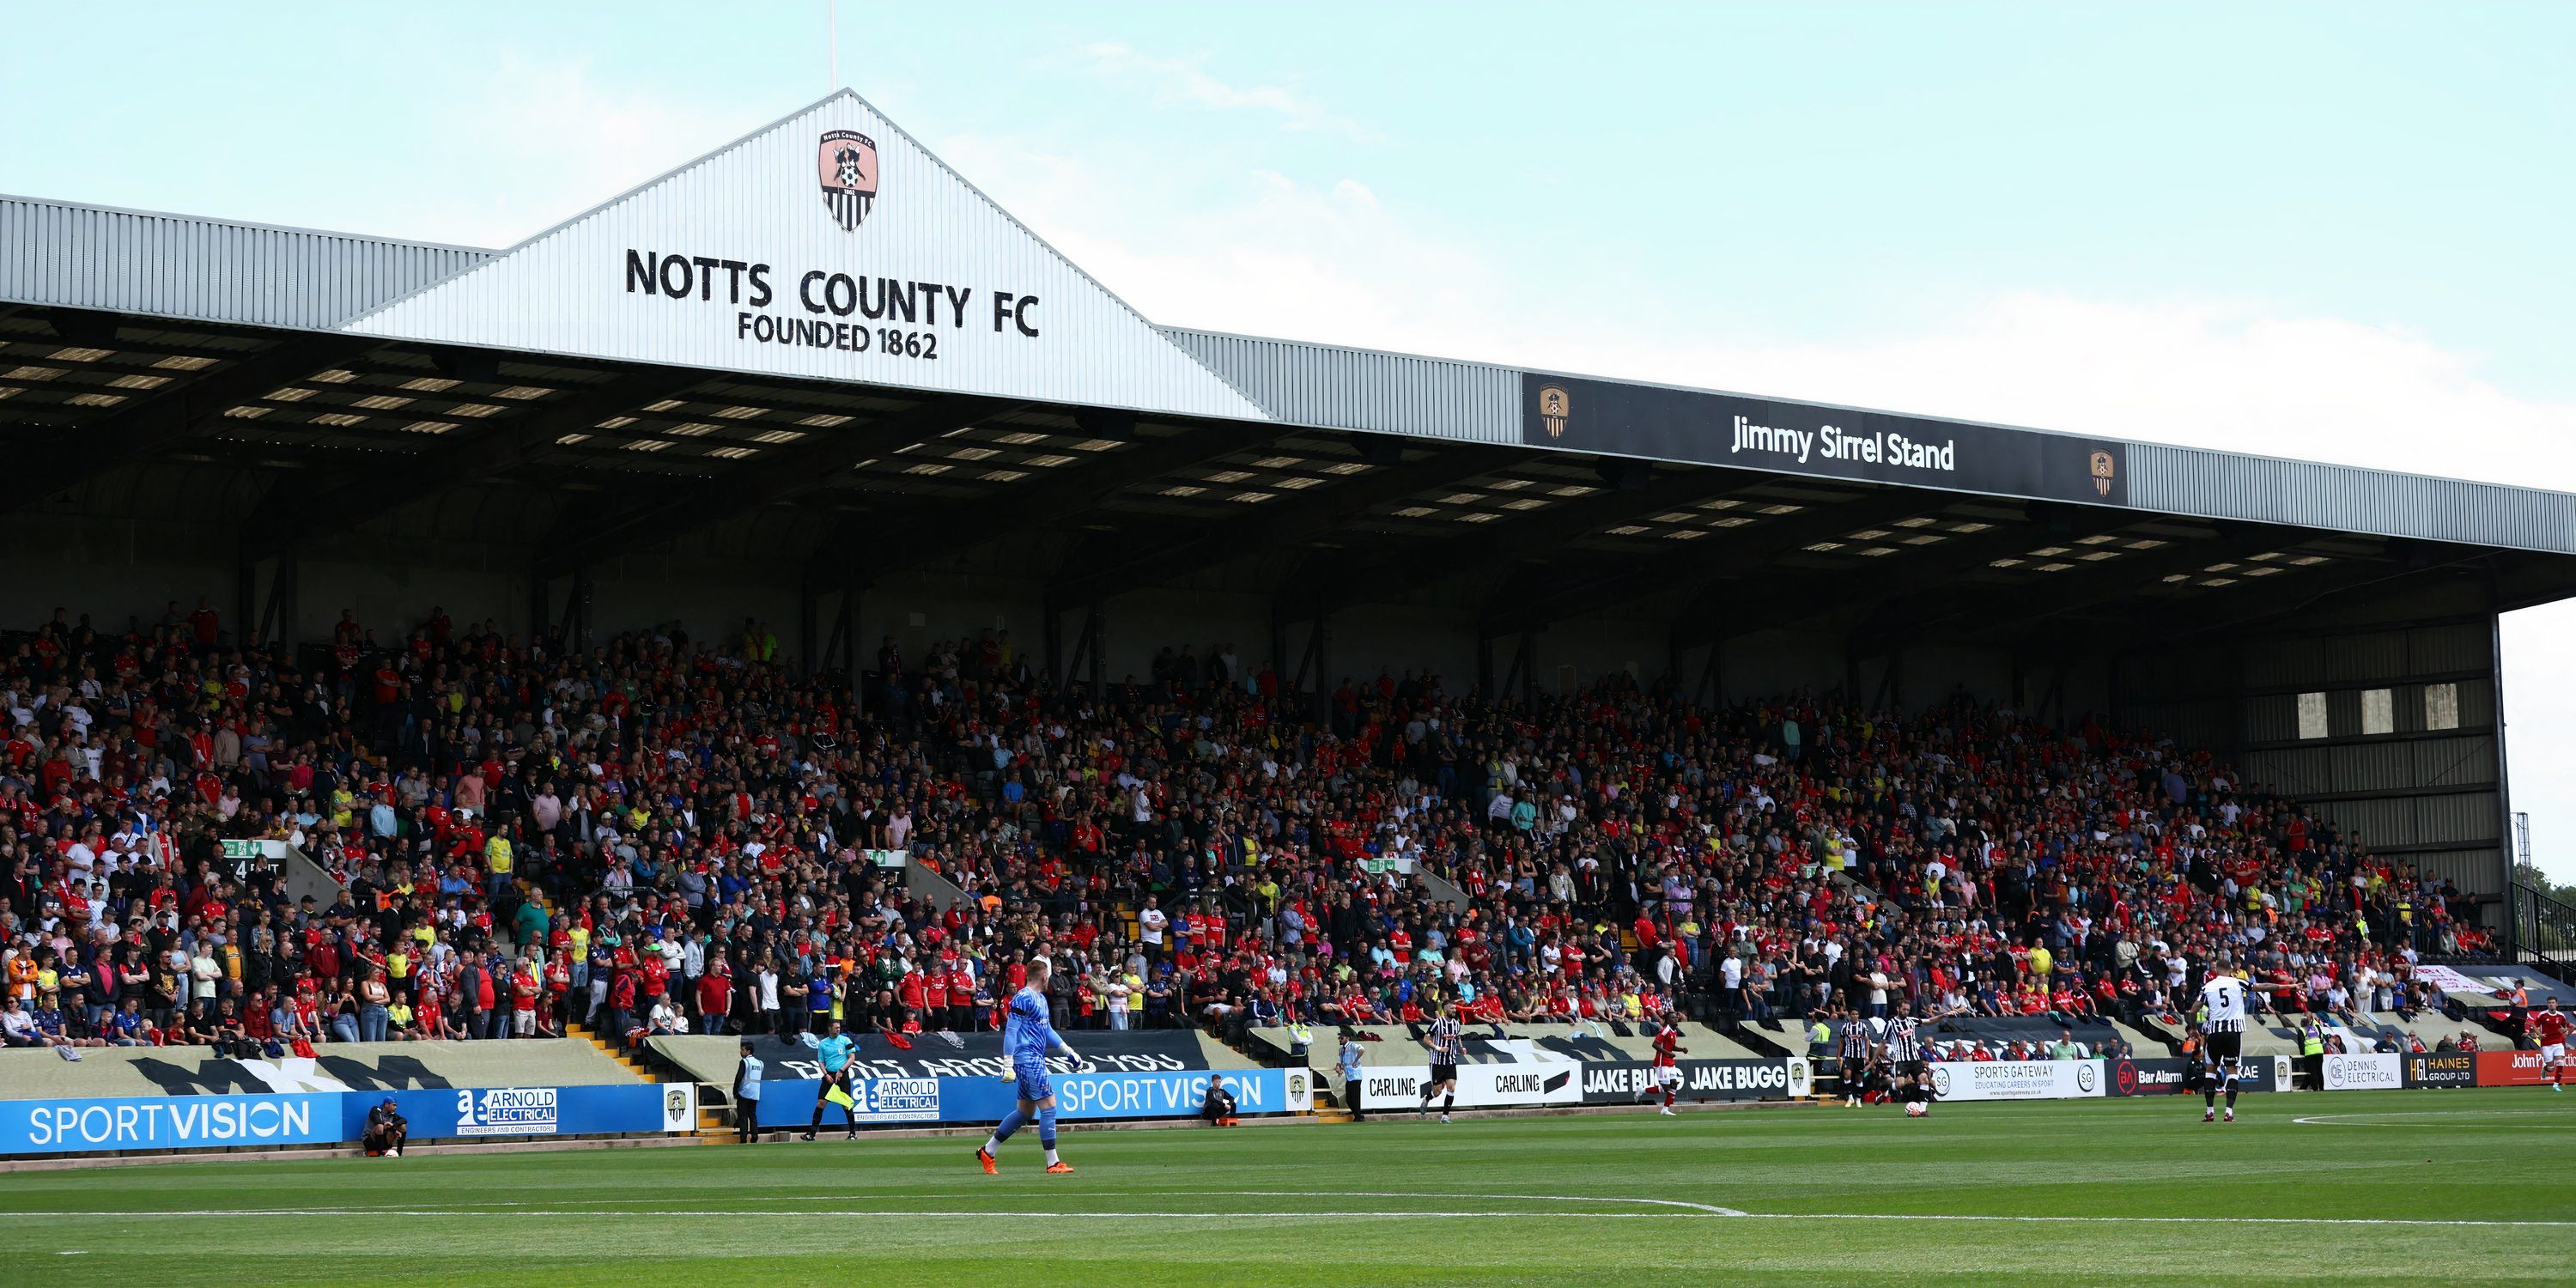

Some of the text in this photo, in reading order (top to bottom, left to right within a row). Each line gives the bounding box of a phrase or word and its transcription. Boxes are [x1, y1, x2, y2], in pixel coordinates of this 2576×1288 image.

[841, 132, 863, 143] County
[626, 249, 1040, 337] NOTTS COUNTY FC
[738, 312, 938, 360] FOUNDED 1862
[1731, 415, 1954, 471] Jimmy Sirrel Stand
[2219, 987, 2230, 1008] 5
[780, 1054, 1185, 1080] BILT AROND YOU
[2348, 1060, 2378, 1071] DENNIS
[2428, 1057, 2470, 1070] HAINES
[2512, 1054, 2535, 1068] John
[1974, 1065, 2054, 1078] SPORTS GATEWAY
[2409, 1058, 2428, 1081] HGL
[2428, 1072, 2470, 1081] GROUP LTD
[1496, 1073, 1540, 1093] CARLING
[1583, 1066, 1685, 1093] JAKE BUG
[1690, 1065, 1786, 1091] JAKE BUGG
[1936, 1076, 1947, 1087] SG
[1975, 1080, 2006, 1090] EDUCATING
[2007, 1080, 2031, 1089] CAREERS
[2038, 1079, 2054, 1088] SPORT
[2081, 1072, 2093, 1083] SG
[2348, 1072, 2395, 1083] ELECTRICAL
[882, 1080, 937, 1096] ARNOLD
[1370, 1078, 1416, 1097] CARLING
[490, 1091, 555, 1108] ARNOLD
[881, 1096, 938, 1109] ELECTRICAL
[489, 1108, 556, 1121] ELECTRICAL
